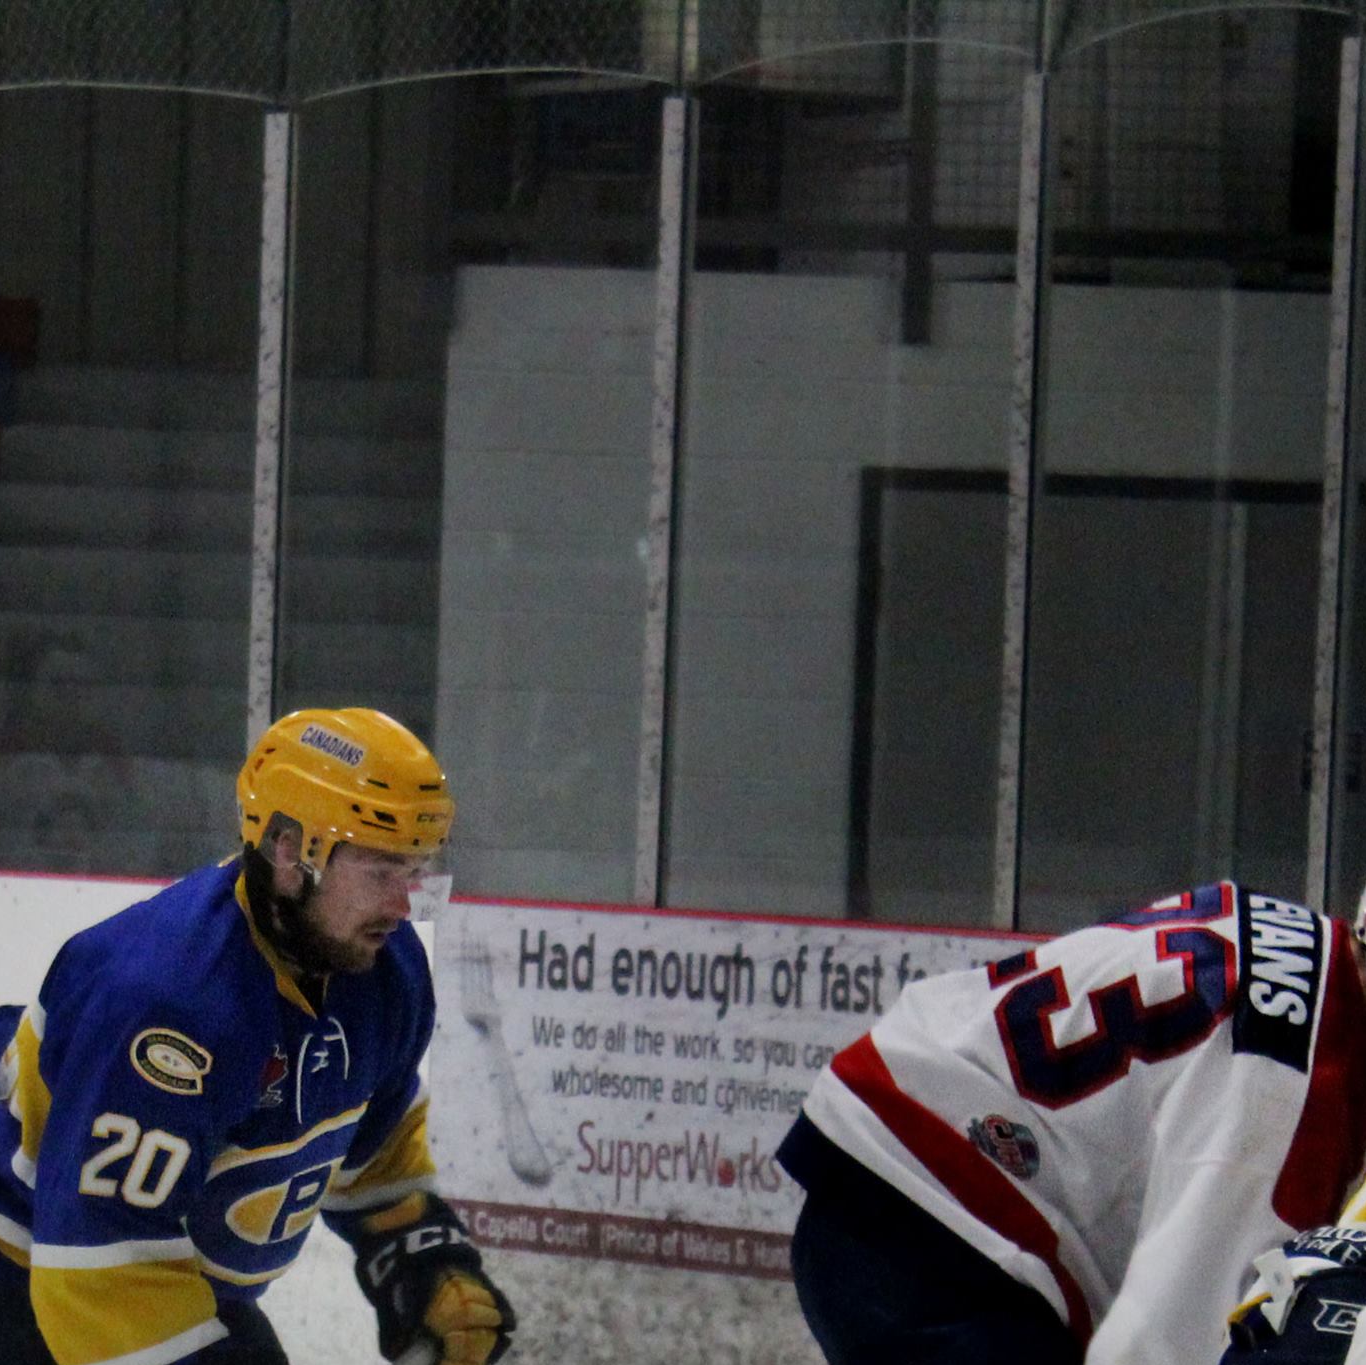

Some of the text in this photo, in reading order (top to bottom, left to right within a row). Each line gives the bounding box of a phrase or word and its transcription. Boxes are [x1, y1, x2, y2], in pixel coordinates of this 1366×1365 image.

[300, 726, 365, 767] CANADIANS
[518, 928, 595, 992] Had
[611, 943, 755, 1020] enough
[771, 945, 808, 1009] of
[821, 946, 883, 1016] fast
[1247, 893, 1318, 1027] EVANS
[532, 1015, 565, 1048] We
[573, 1020, 598, 1050] do
[604, 1021, 626, 1052] all
[634, 1024, 665, 1056] the
[733, 1037, 754, 1064] so
[762, 1039, 795, 1075] you
[552, 1065, 663, 1101] wholesome
[671, 1075, 707, 1106] and
[78, 1111, 192, 1209] 20
[577, 1119, 781, 1202] SupperWorks
